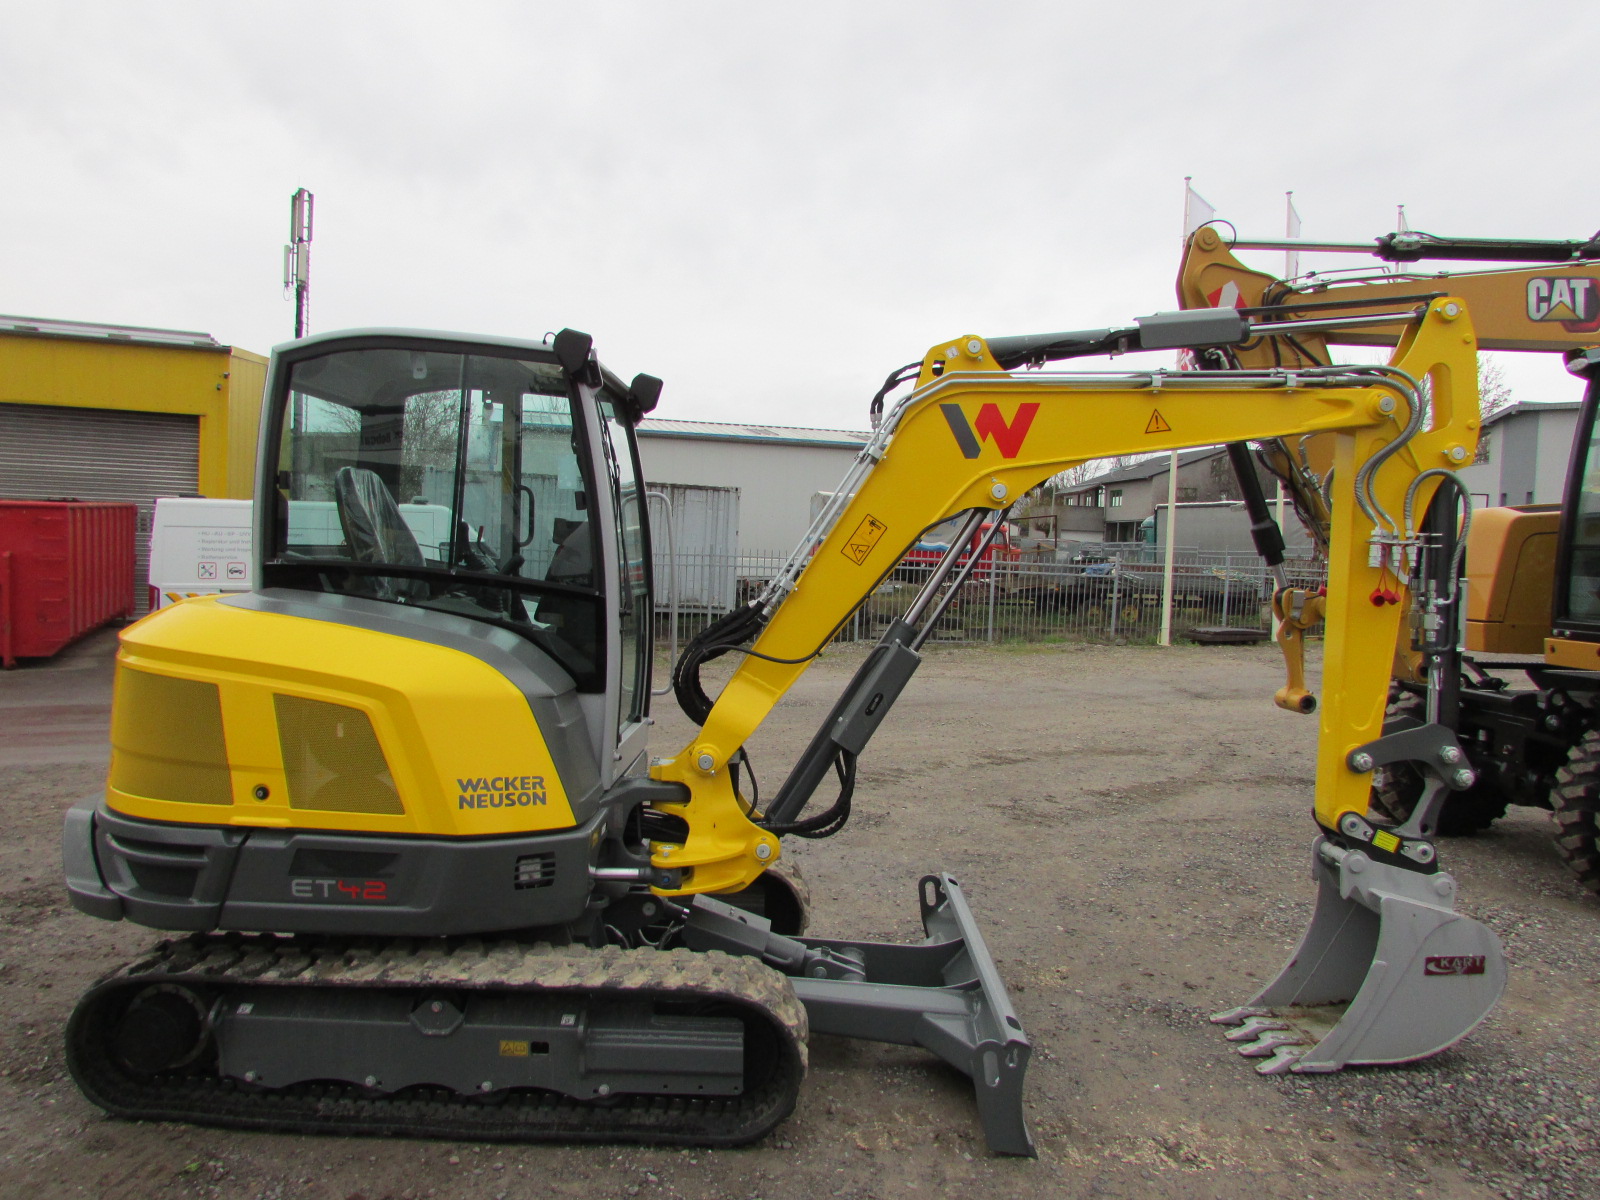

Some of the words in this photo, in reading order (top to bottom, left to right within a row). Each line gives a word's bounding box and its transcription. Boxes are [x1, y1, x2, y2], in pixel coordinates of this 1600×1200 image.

[1527, 278, 1590, 320] CAT
[457, 775, 546, 793] WACKER
[458, 791, 547, 810] NEUSON
